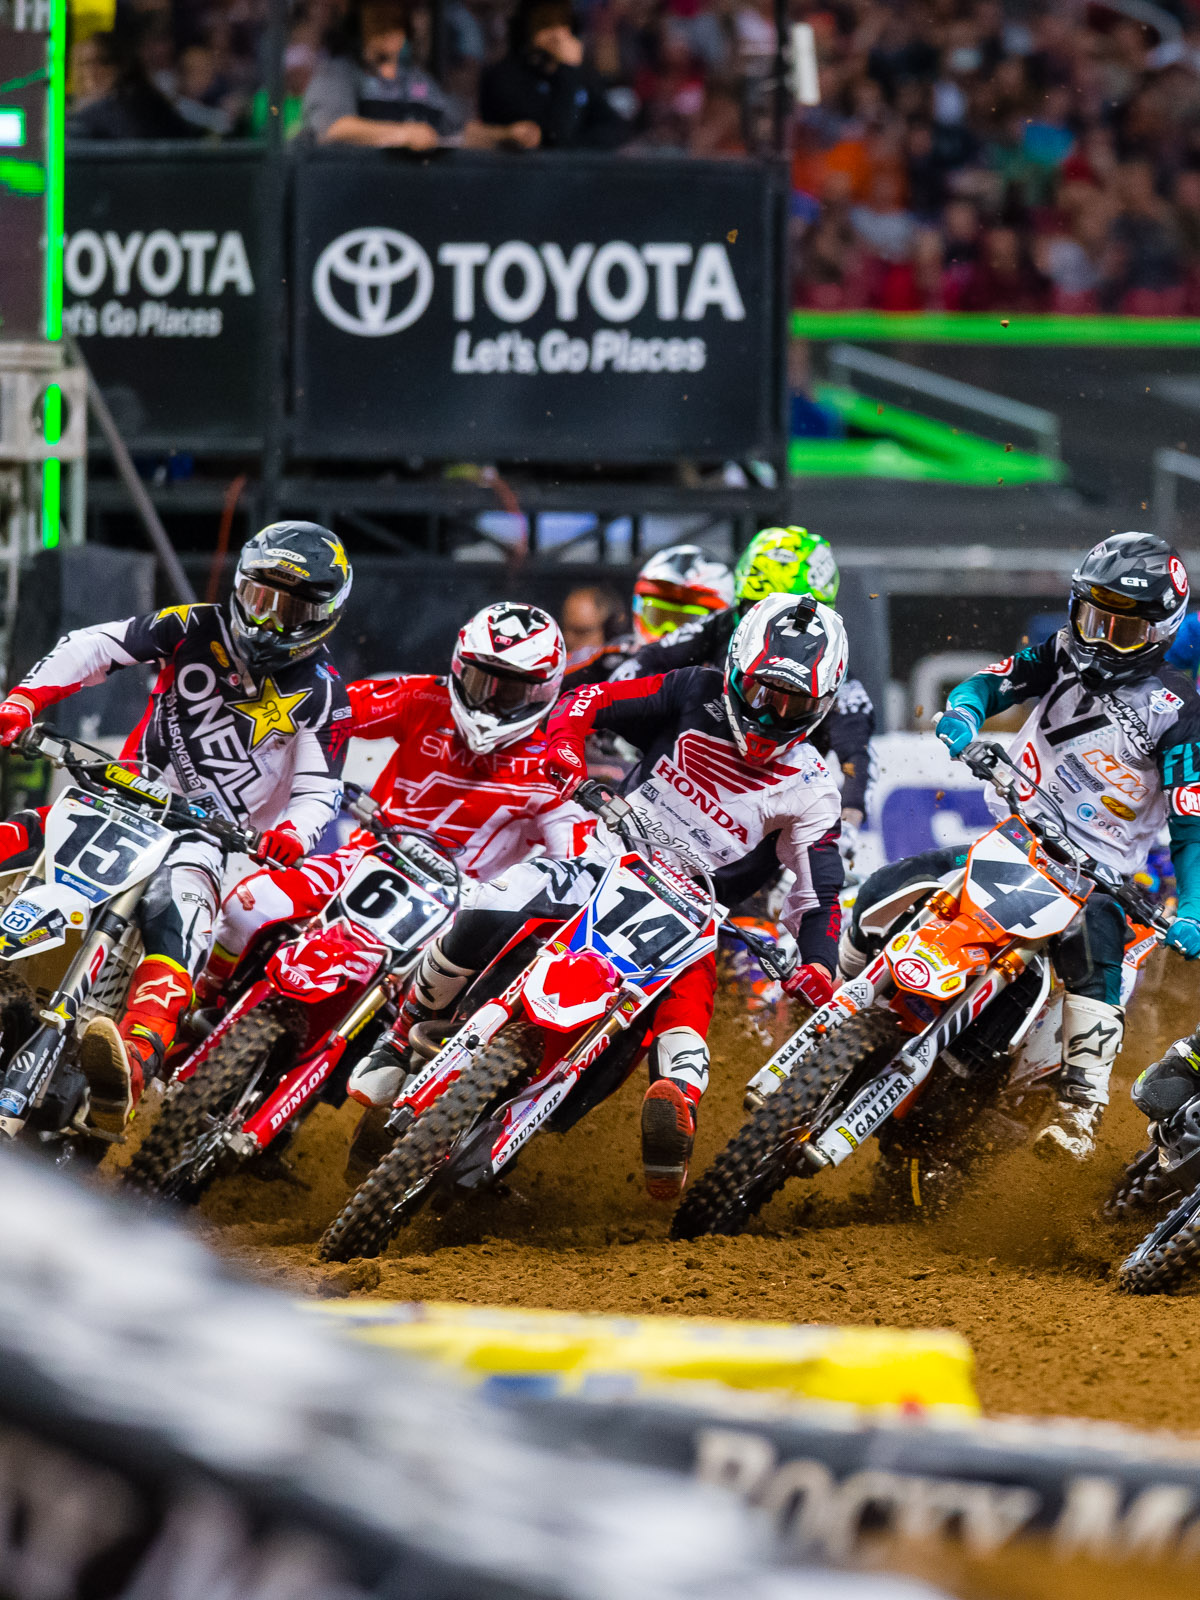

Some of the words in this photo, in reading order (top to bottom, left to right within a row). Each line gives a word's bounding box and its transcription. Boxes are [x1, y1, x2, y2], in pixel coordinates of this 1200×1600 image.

[42, 229, 255, 297] OYOTA
[438, 241, 746, 322] TOYOTA
[101, 300, 138, 337] Go
[138, 301, 223, 337] Places
[453, 331, 537, 373] Let's
[540, 334, 589, 372] Go
[591, 331, 706, 372] Places
[167, 706, 202, 790] Husqvarna
[1082, 749, 1150, 802] KTM
[656, 759, 750, 846] HONDA
[54, 813, 152, 886] 15
[346, 869, 440, 946] 61
[593, 886, 692, 970] 14
[970, 859, 1062, 931] 4
[531, 998, 557, 1022] HONDA
[270, 1060, 330, 1130] DUNLOP
[510, 1090, 562, 1152] DUNLOP
[855, 1077, 908, 1138] GALFER
